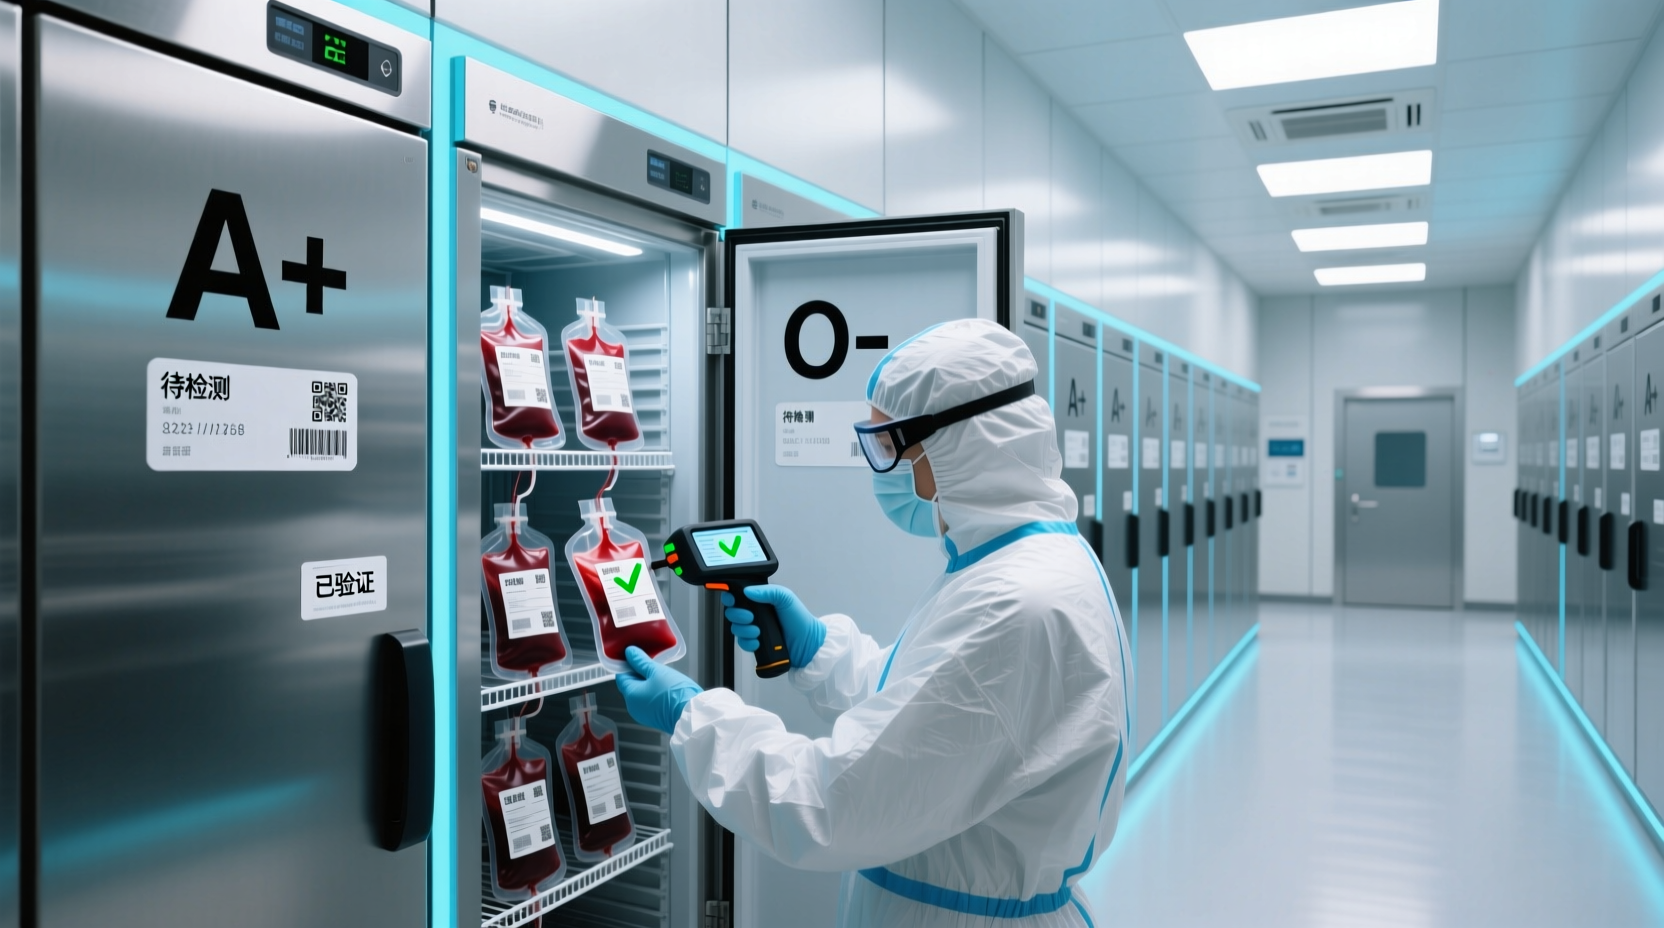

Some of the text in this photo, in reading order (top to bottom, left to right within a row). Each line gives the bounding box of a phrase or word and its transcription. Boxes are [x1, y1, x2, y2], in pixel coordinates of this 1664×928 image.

[166, 188, 347, 330] A+
[784, 300, 889, 379] O-
[161, 371, 231, 401] 待检测
[316, 571, 375, 598] 已验证
